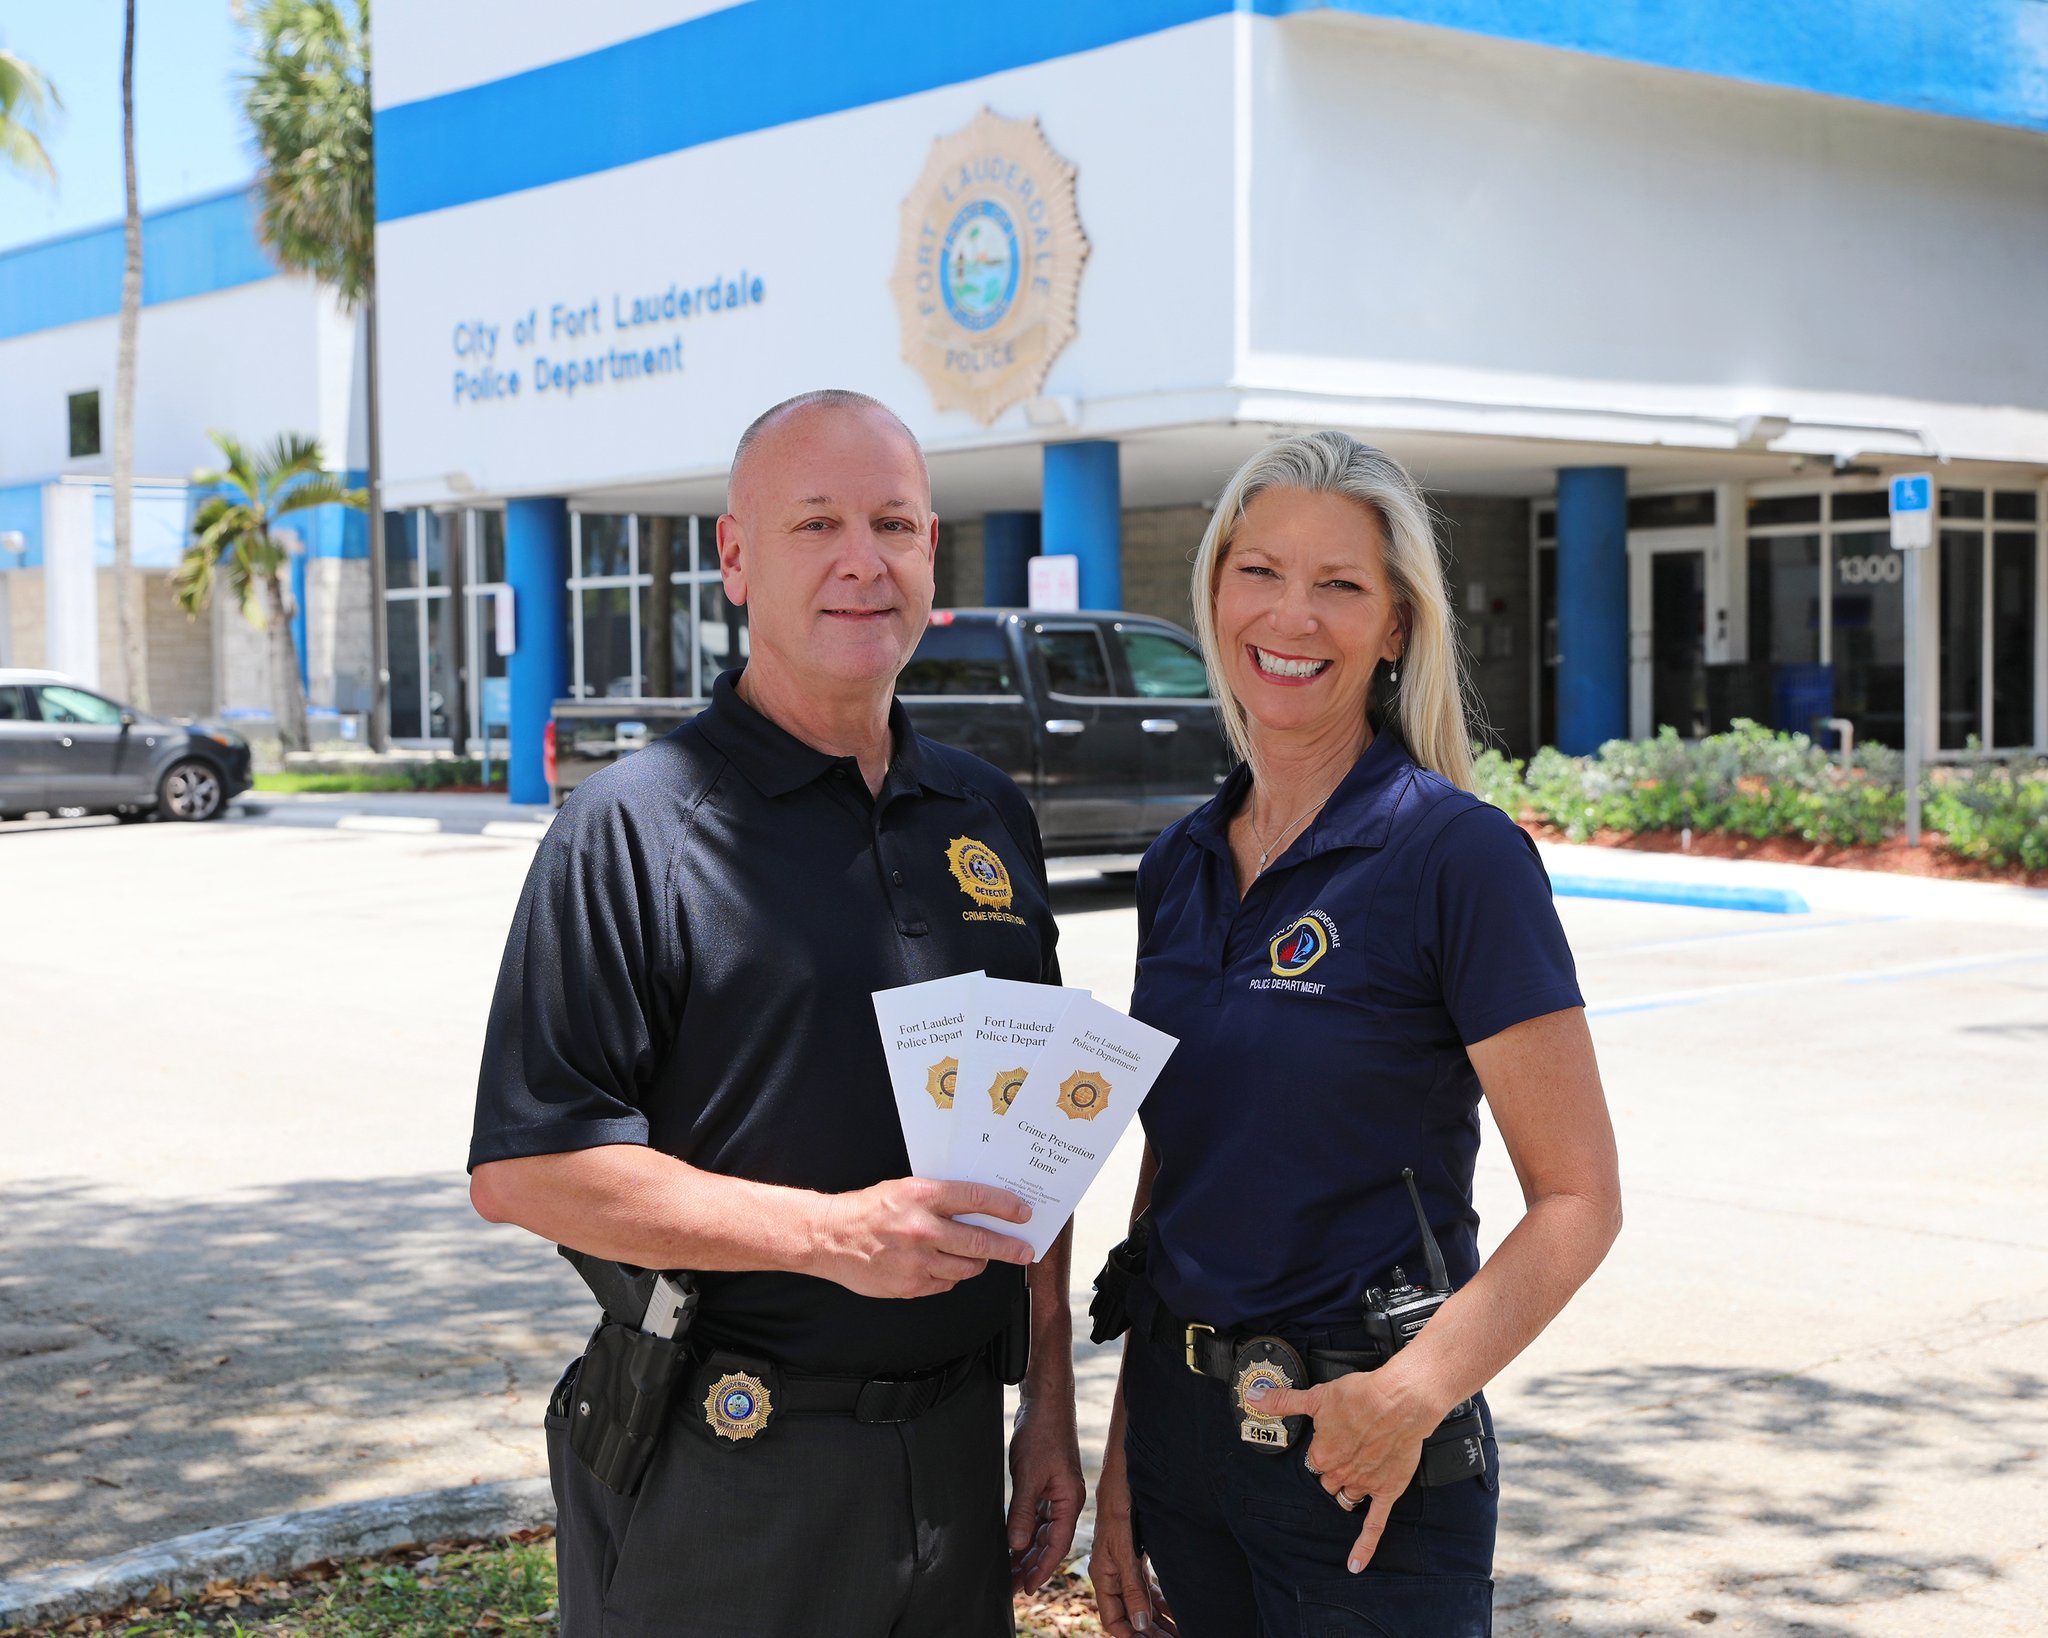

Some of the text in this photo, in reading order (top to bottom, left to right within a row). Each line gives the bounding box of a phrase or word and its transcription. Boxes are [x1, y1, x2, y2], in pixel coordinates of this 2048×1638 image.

[915, 222, 936, 318] FORT
[942, 154, 1052, 297] LAUDERDALE
[453, 269, 765, 359] City of Fort Lauderdale
[945, 342, 1017, 374] POLICE
[454, 336, 684, 405] Police Department
[1839, 554, 1902, 584] 1300
[962, 910, 988, 921] CRIME
[1249, 978, 1326, 995] POLICE DEPARTMENT
[899, 1012, 965, 1035] Fort Lauderd
[984, 1016, 1006, 1028] Fort
[896, 1037, 928, 1051] Police
[975, 1029, 1048, 1048] Police Depart
[1084, 1030, 1142, 1062] Fort Lauderdale
[1071, 1037, 1139, 1073] Police Department
[981, 1133, 990, 1143] R
[1018, 1119, 1096, 1161] Crime Prevention
[1030, 1142, 1070, 1165] for Your
[1029, 1156, 1057, 1175] Home
[1252, 1428, 1277, 1443] 467
